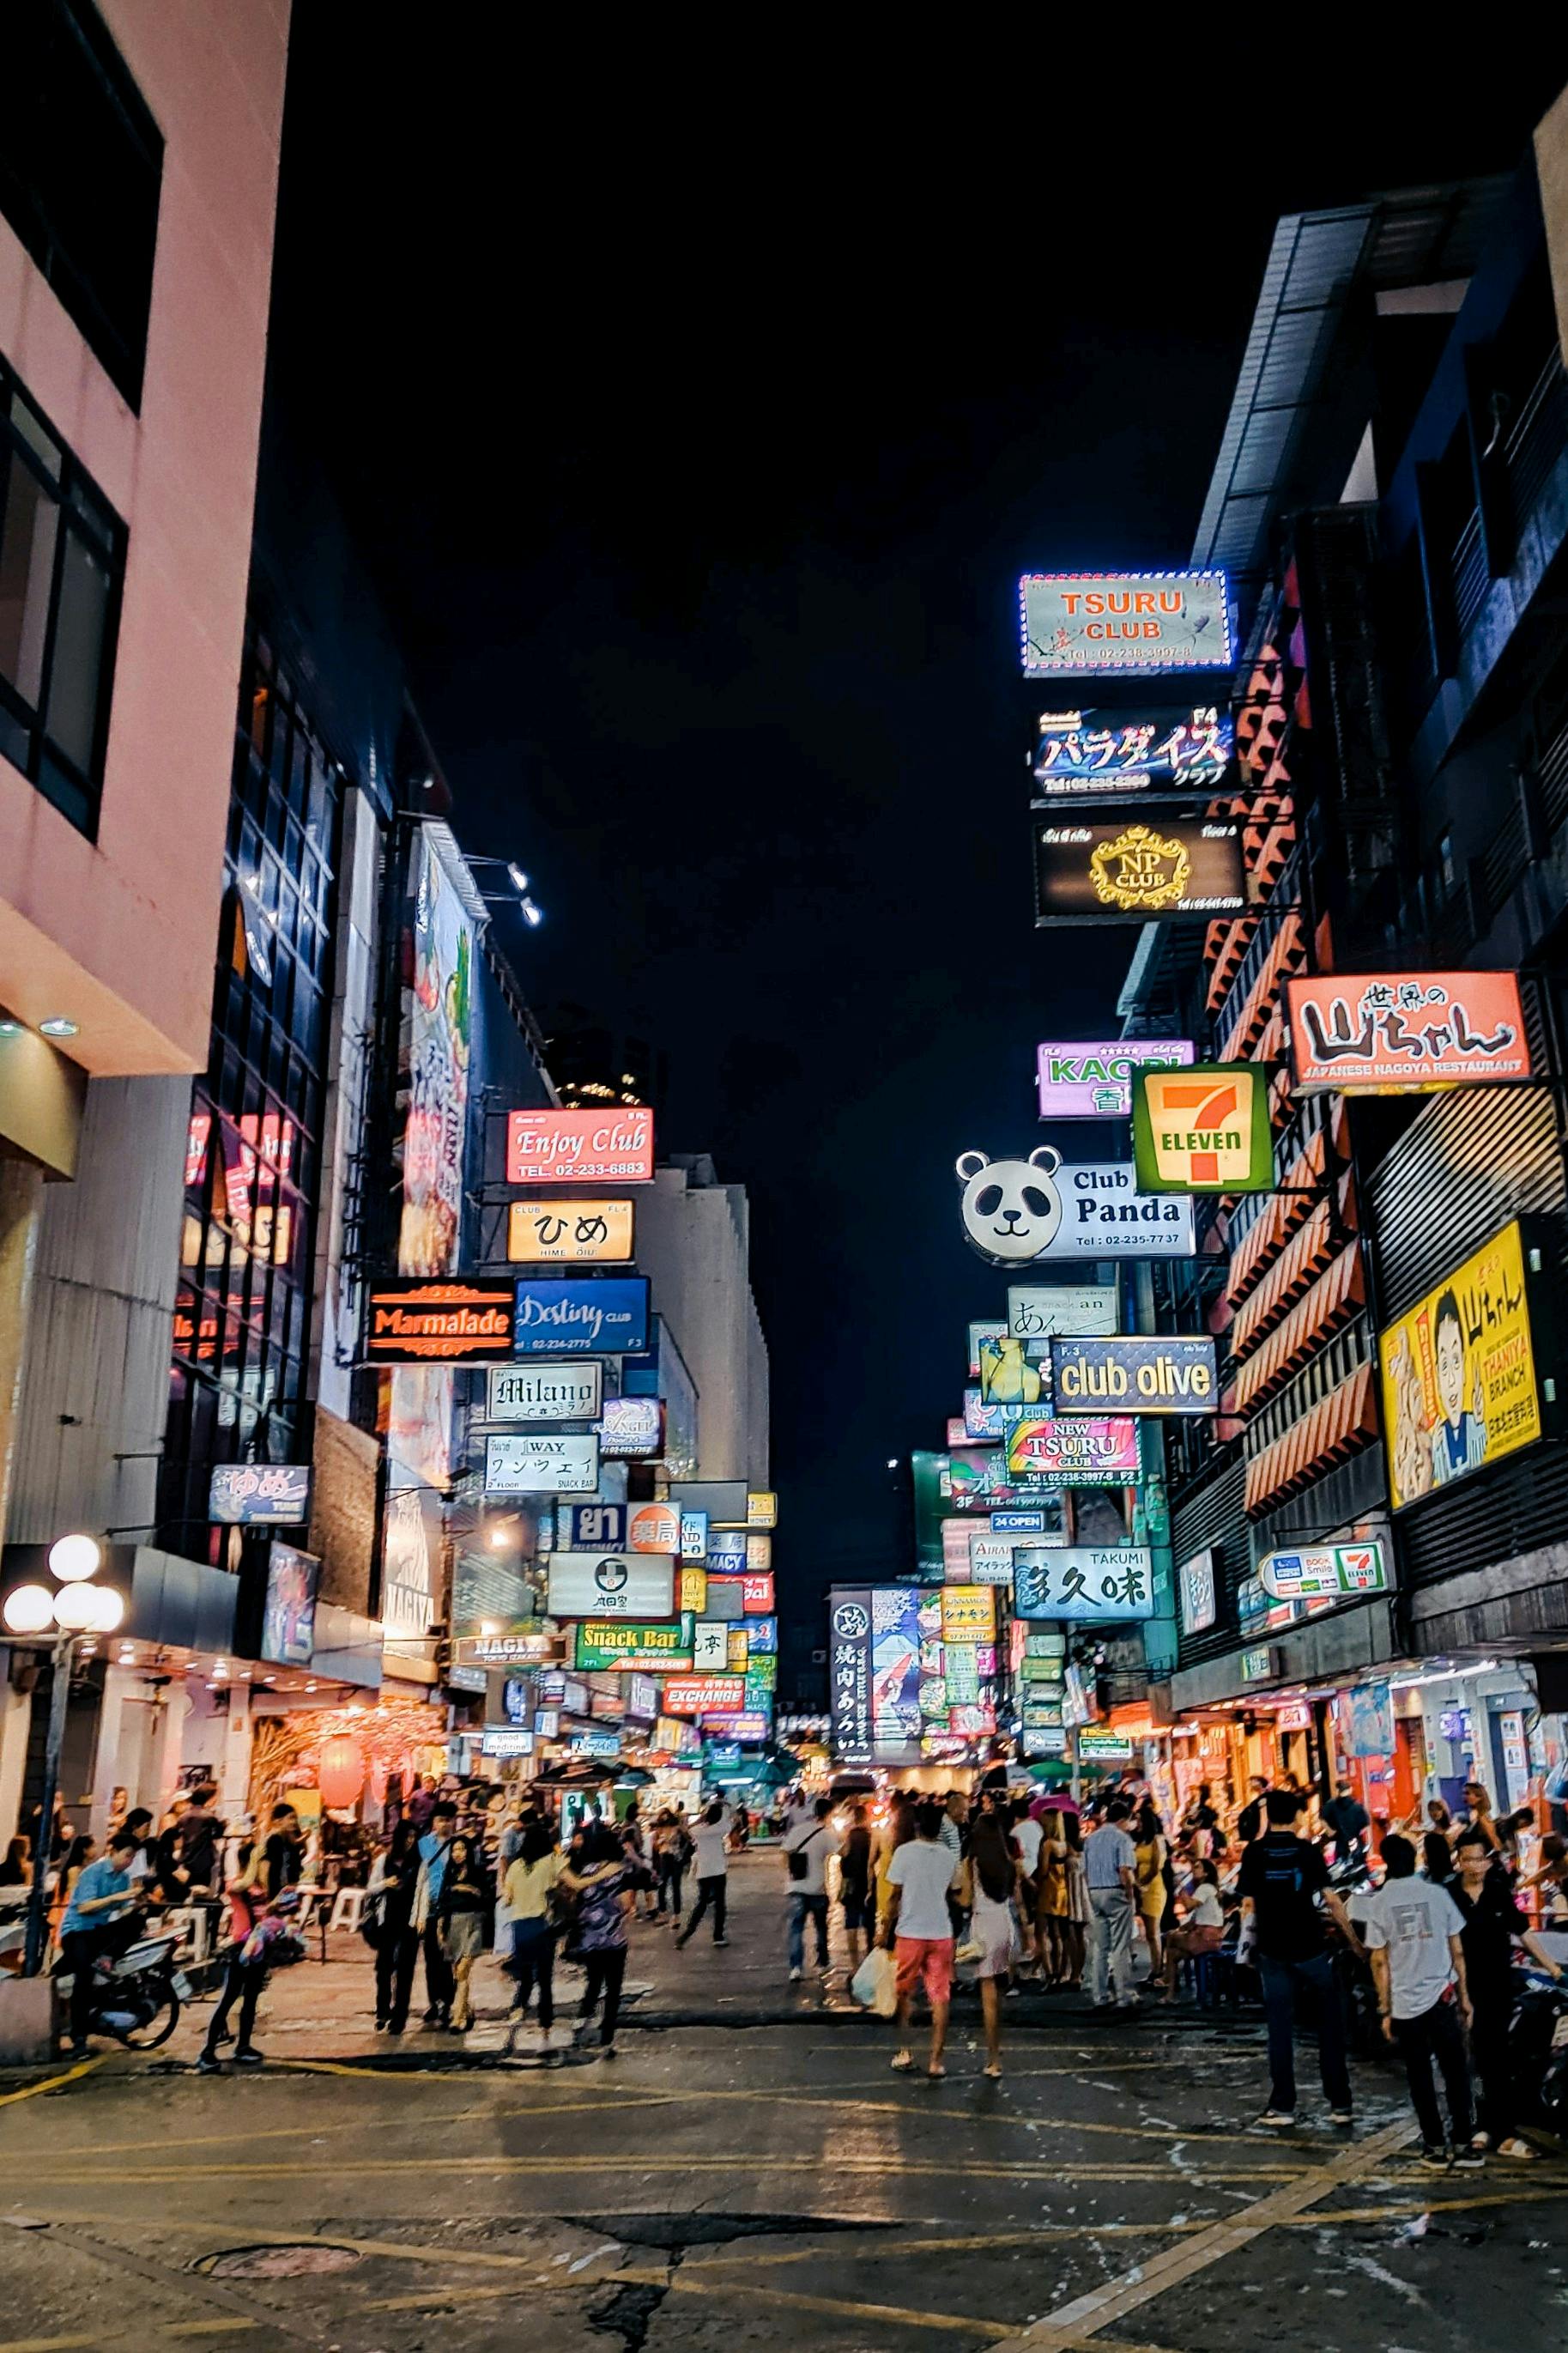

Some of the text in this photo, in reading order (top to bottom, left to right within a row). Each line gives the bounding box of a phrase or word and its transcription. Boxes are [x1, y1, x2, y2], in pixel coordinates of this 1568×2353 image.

[1061, 591, 1183, 615] TSURU
[1087, 622, 1161, 640] CLUB
[1044, 725, 1228, 771] パラダイス
[1120, 853, 1161, 874] NP
[1116, 873, 1165, 888] CLUB
[1365, 984, 1445, 1010] 世界の
[1304, 1002, 1513, 1061] 山ちゃん
[1303, 1059, 1523, 1079] JAPANESE NAGOYA RESTAURANT
[1163, 1086, 1237, 1130] 7
[518, 1123, 647, 1165] Enjoy Club
[518, 1162, 645, 1178] TEL. 02-233-6883
[1074, 1171, 1129, 1190] Club
[1076, 1197, 1181, 1223] Panda
[534, 1215, 608, 1245] ひめ
[374, 1307, 510, 1335] Marmalade
[515, 1295, 633, 1339] Destiny CLUB
[1483, 1334, 1529, 1383] THANIYA
[1061, 1356, 1210, 1398] club olive
[1489, 1361, 1527, 1402] BRANCH
[496, 1377, 593, 1405] Milano
[1025, 1409, 1049, 1419] Club
[1053, 1423, 1091, 1436] NEW
[1026, 1436, 1117, 1457] TSURU
[1056, 1456, 1093, 1468] CLUB
[558, 1479, 578, 1489] SNACK
[1026, 1472, 1041, 1483] Tel
[578, 1507, 620, 1541] ยา
[995, 1515, 1040, 1526] 24 OPEN
[1090, 1553, 1144, 1565] TAKUMI
[1305, 1557, 1331, 1567] BOOK
[1306, 1565, 1333, 1574] Smile
[1024, 1566, 1147, 1610] 多久味
[584, 1629, 678, 1648] Snack Bar
[667, 1690, 742, 1703] EXCHANGE
